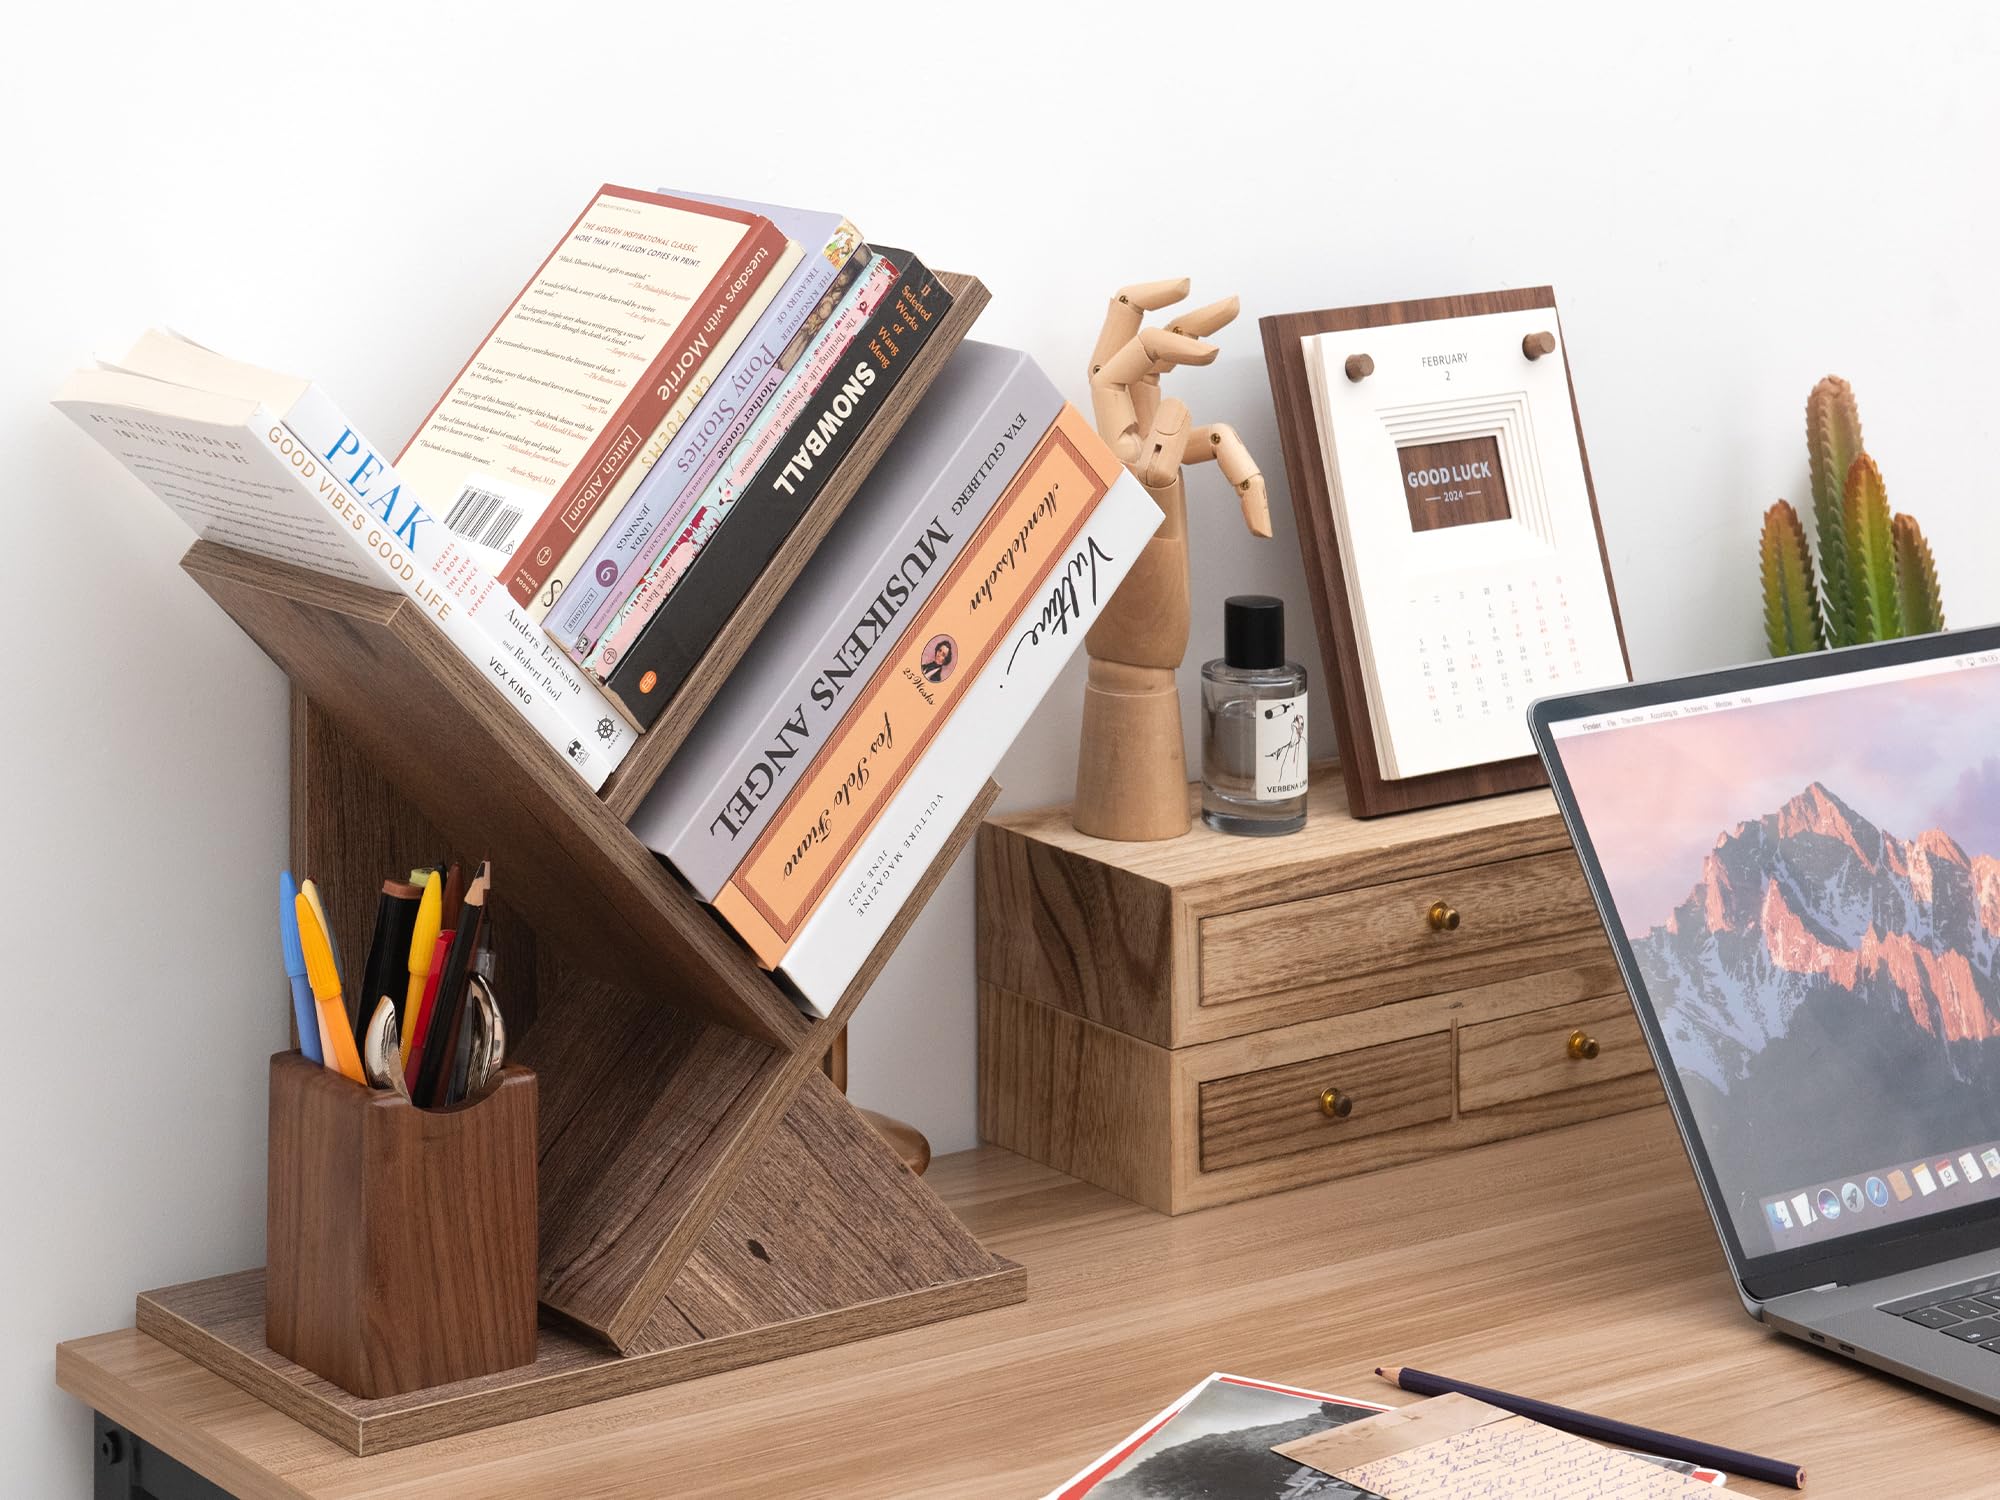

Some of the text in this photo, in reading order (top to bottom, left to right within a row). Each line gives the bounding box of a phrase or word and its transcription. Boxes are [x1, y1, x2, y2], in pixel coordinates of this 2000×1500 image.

[583, 222, 596, 230] THE
[594, 226, 622, 234] MODERN
[622, 230, 669, 245] INSPIRATIONAL
[574, 234, 592, 242] MORE
[592, 237, 610, 245] THAN
[619, 244, 646, 253] MILLION
[646, 249, 670, 259] COPIES
[679, 257, 702, 266] PRINT.
[776, 267, 819, 324] TREASURY OF
[780, 272, 832, 340] THE KINGFISHER
[901, 285, 931, 321] Selected
[656, 247, 768, 400] tuesdays with Morrie
[844, 317, 856, 331] The
[892, 323, 904, 334] of
[895, 299, 918, 330] Works
[818, 332, 846, 365] Thrilling
[868, 338, 889, 368] Meng
[878, 325, 898, 356] Wang
[807, 365, 822, 381] Life
[1421, 352, 1468, 368] FEBRUARY
[1444, 370, 1451, 382] 2
[801, 381, 808, 392] of
[677, 342, 776, 472] Pony Stories
[716, 377, 776, 458] Mother Goose
[780, 390, 803, 418] Pauline
[641, 375, 710, 473] CAT POEMS
[772, 419, 781, 429] de
[772, 361, 875, 494] SNOWBALL
[568, 435, 632, 520] Mitch Albom
[951, 412, 1026, 515] EVA GULLBERG
[1407, 460, 1492, 488] GOOD LUCK
[322, 425, 433, 552] PEAK
[685, 490, 692, 499] by
[1444, 490, 1464, 502] 2024
[268, 426, 451, 621] GOOD VIBES GOOD LIFE
[616, 503, 649, 550] JENNINGS
[665, 499, 686, 526] ARTHUR
[630, 522, 652, 549] LINDA
[642, 526, 666, 560] RACKHAM
[970, 483, 1058, 614] Mendelssohn
[432, 542, 456, 572] SECRETS
[442, 554, 460, 576] FROM
[446, 574, 458, 590] THE
[458, 557, 472, 575] NEW
[454, 566, 478, 597] SCIENCE
[515, 576, 530, 593] BOOKS
[519, 568, 537, 588] ANCHOR
[641, 566, 676, 612] Edeet Ravel
[468, 578, 496, 617] EXPERTISE
[469, 584, 479, 597] OF
[1006, 536, 1112, 674] Vulture
[504, 608, 582, 696] Anders Ericsson
[489, 656, 531, 704] VEX KING
[502, 640, 561, 700] and Robert Pool
[709, 515, 953, 840] MUSIKENS ANGEL
[902, 667, 914, 680] 25
[1582, 722, 1602, 731] Finder
[1715, 700, 1732, 708] Window
[833, 757, 868, 807] Solo
[1266, 784, 1298, 793] VERBENA
[856, 794, 942, 916] VULTURE MAGAZINE
[848, 850, 886, 905] JUNE 2022
[1944, 1170, 1951, 1180] 9
